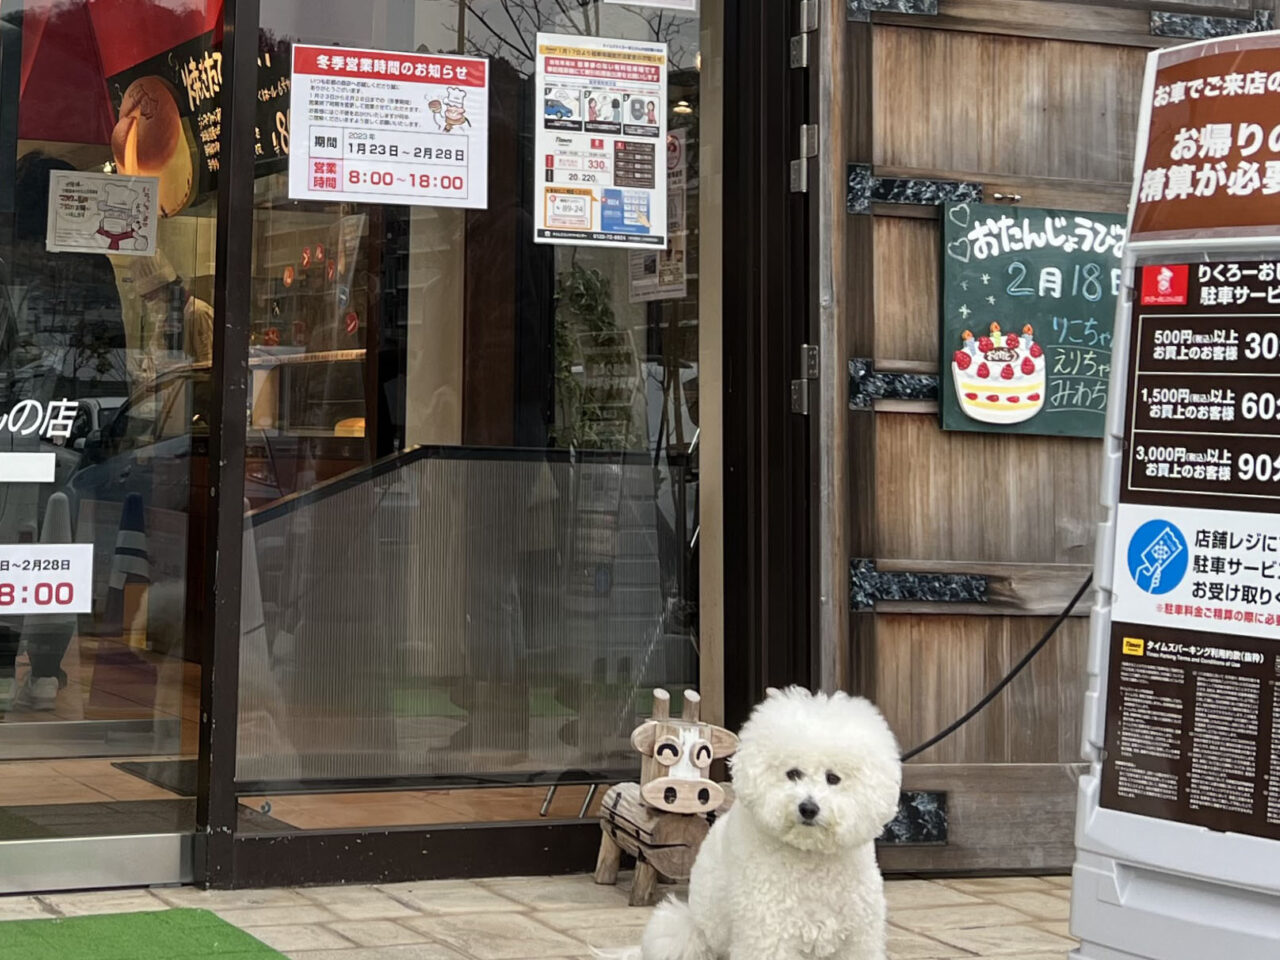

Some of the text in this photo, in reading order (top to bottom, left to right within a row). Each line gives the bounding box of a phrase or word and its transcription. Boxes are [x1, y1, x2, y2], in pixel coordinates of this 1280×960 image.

[316, 54, 468, 79] 冬季営業時間のお知らせ
[314, 136, 337, 149] 期間
[314, 162, 337, 175] 営業
[313, 176, 337, 189] 時間
[1198, 264, 1280, 282] りくろーお
[1053, 317, 1113, 347] りこちゃ
[1245, 332, 1280, 360] 30
[1241, 392, 1280, 420] 60
[1195, 529, 1280, 552] 店舗レジに
[1193, 555, 1280, 579] 駐車サービ
